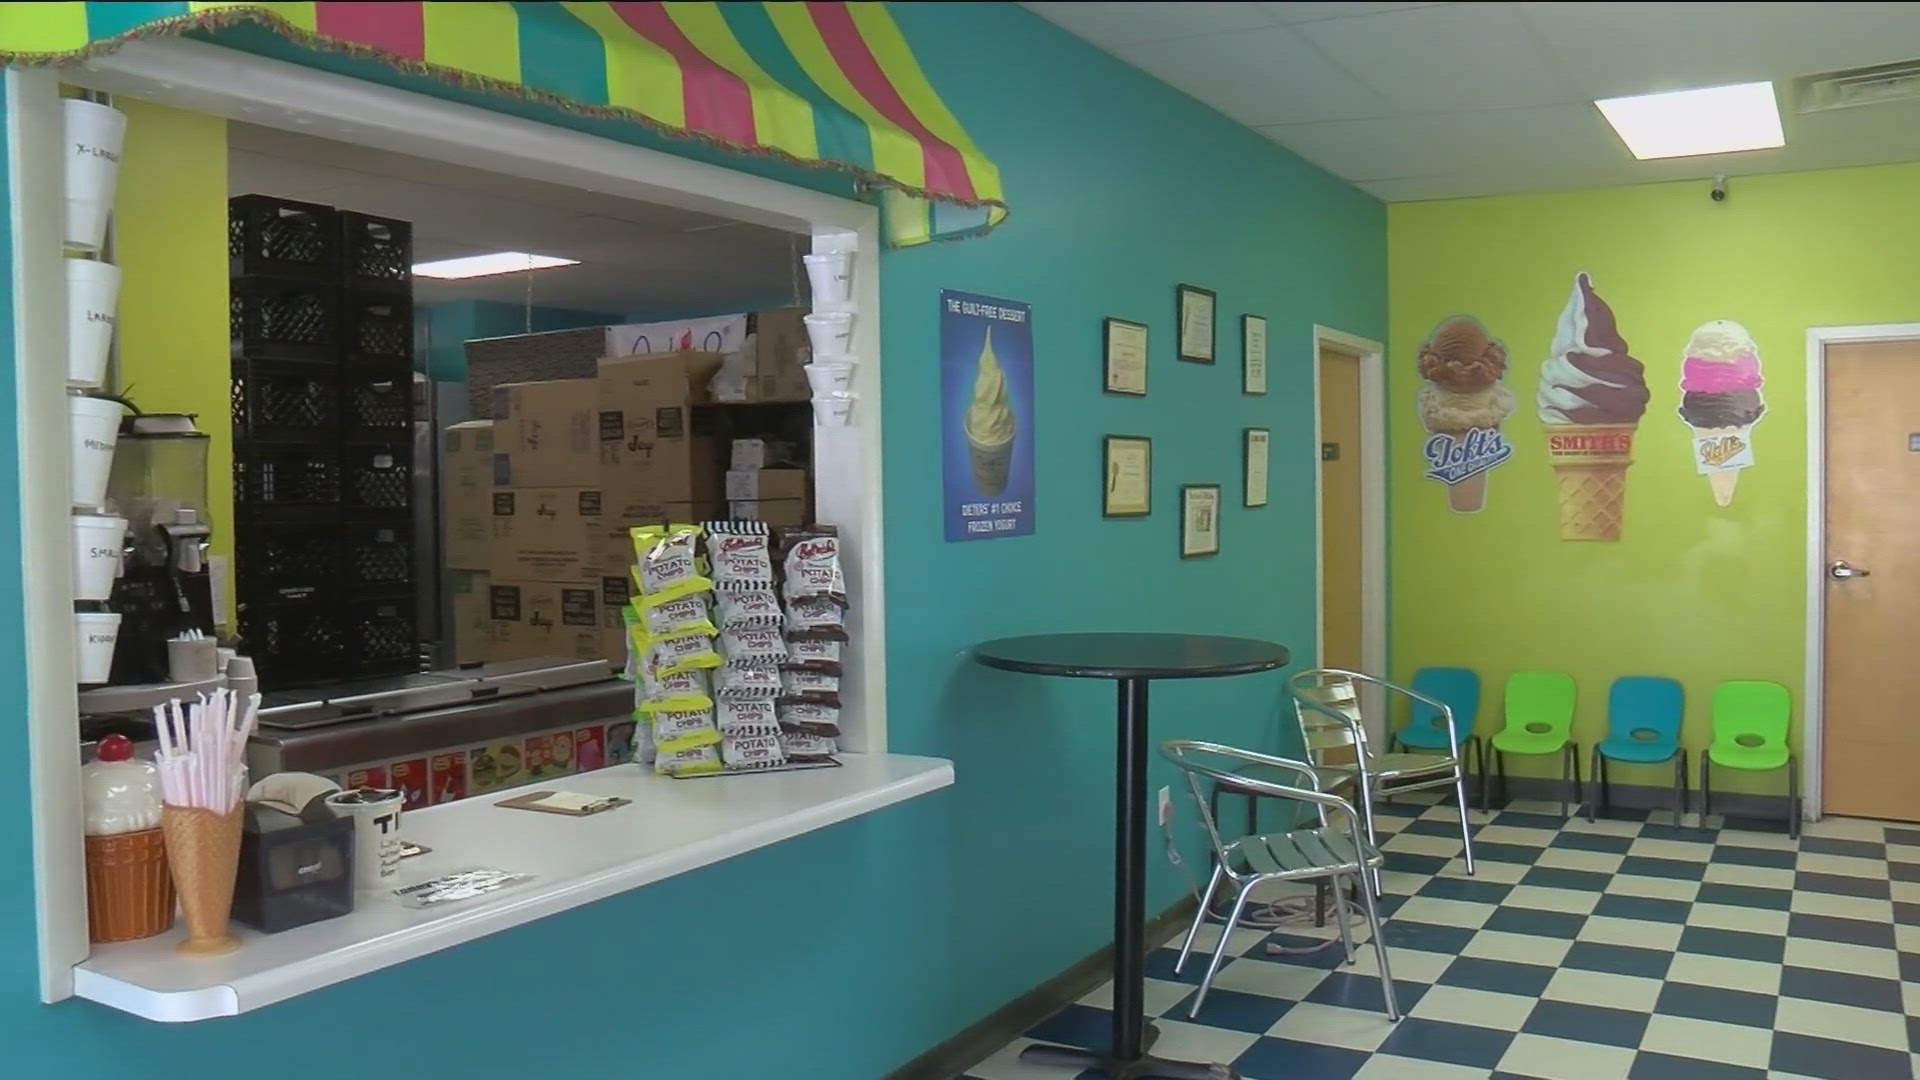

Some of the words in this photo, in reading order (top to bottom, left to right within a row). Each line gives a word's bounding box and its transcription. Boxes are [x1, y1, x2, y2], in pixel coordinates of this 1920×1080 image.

[947, 299, 960, 313] THE
[962, 301, 997, 318] GUILT-FREE
[998, 307, 1025, 322] DESSERT
[1550, 433, 1631, 450] SMITH'S
[991, 503, 1000, 514] #1
[1001, 501, 1022, 514] CHOICE
[968, 521, 993, 533] FROZEN
[995, 519, 1016, 530] YOGURT
[649, 559, 691, 576] POTATO
[725, 559, 767, 569] POTATO
[734, 591, 775, 604] POTATO
[660, 601, 703, 613] POTATO
[668, 609, 696, 620] CHIPS
[737, 631, 779, 642] POTATO
[674, 641, 701, 652] CHIPS
[663, 681, 690, 690] CHIPS
[729, 703, 772, 713] POTATO
[737, 713, 763, 721] CHIPS
[675, 718, 703, 728] CHIPS
[734, 738, 775, 751] POTATO
[743, 749, 769, 758] CHIPS
